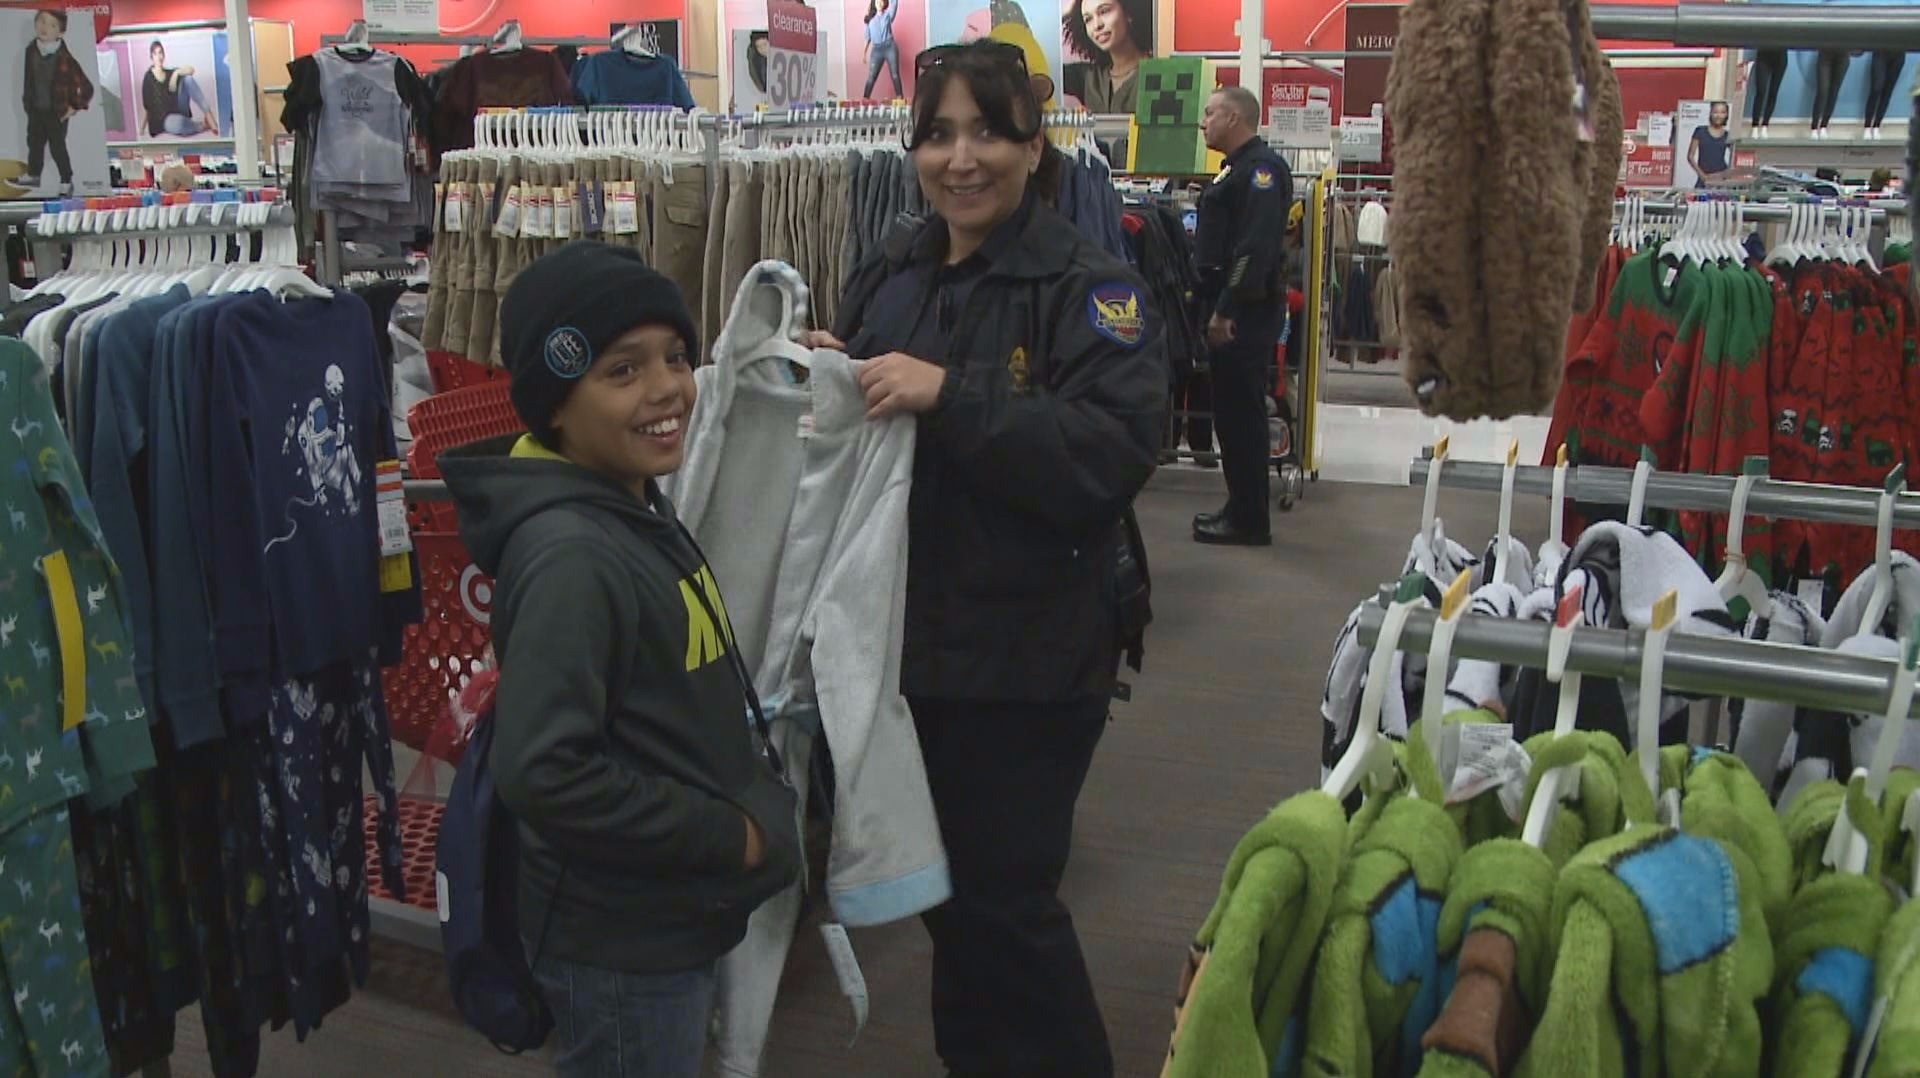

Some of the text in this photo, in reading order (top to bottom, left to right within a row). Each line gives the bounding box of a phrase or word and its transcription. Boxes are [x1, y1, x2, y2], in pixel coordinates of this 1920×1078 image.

[773, 9, 813, 36] clearance
[771, 51, 816, 106] 30%
[1272, 84, 1305, 94] Get the
[1272, 92, 1305, 101] coupon
[1637, 163, 1652, 174] for
